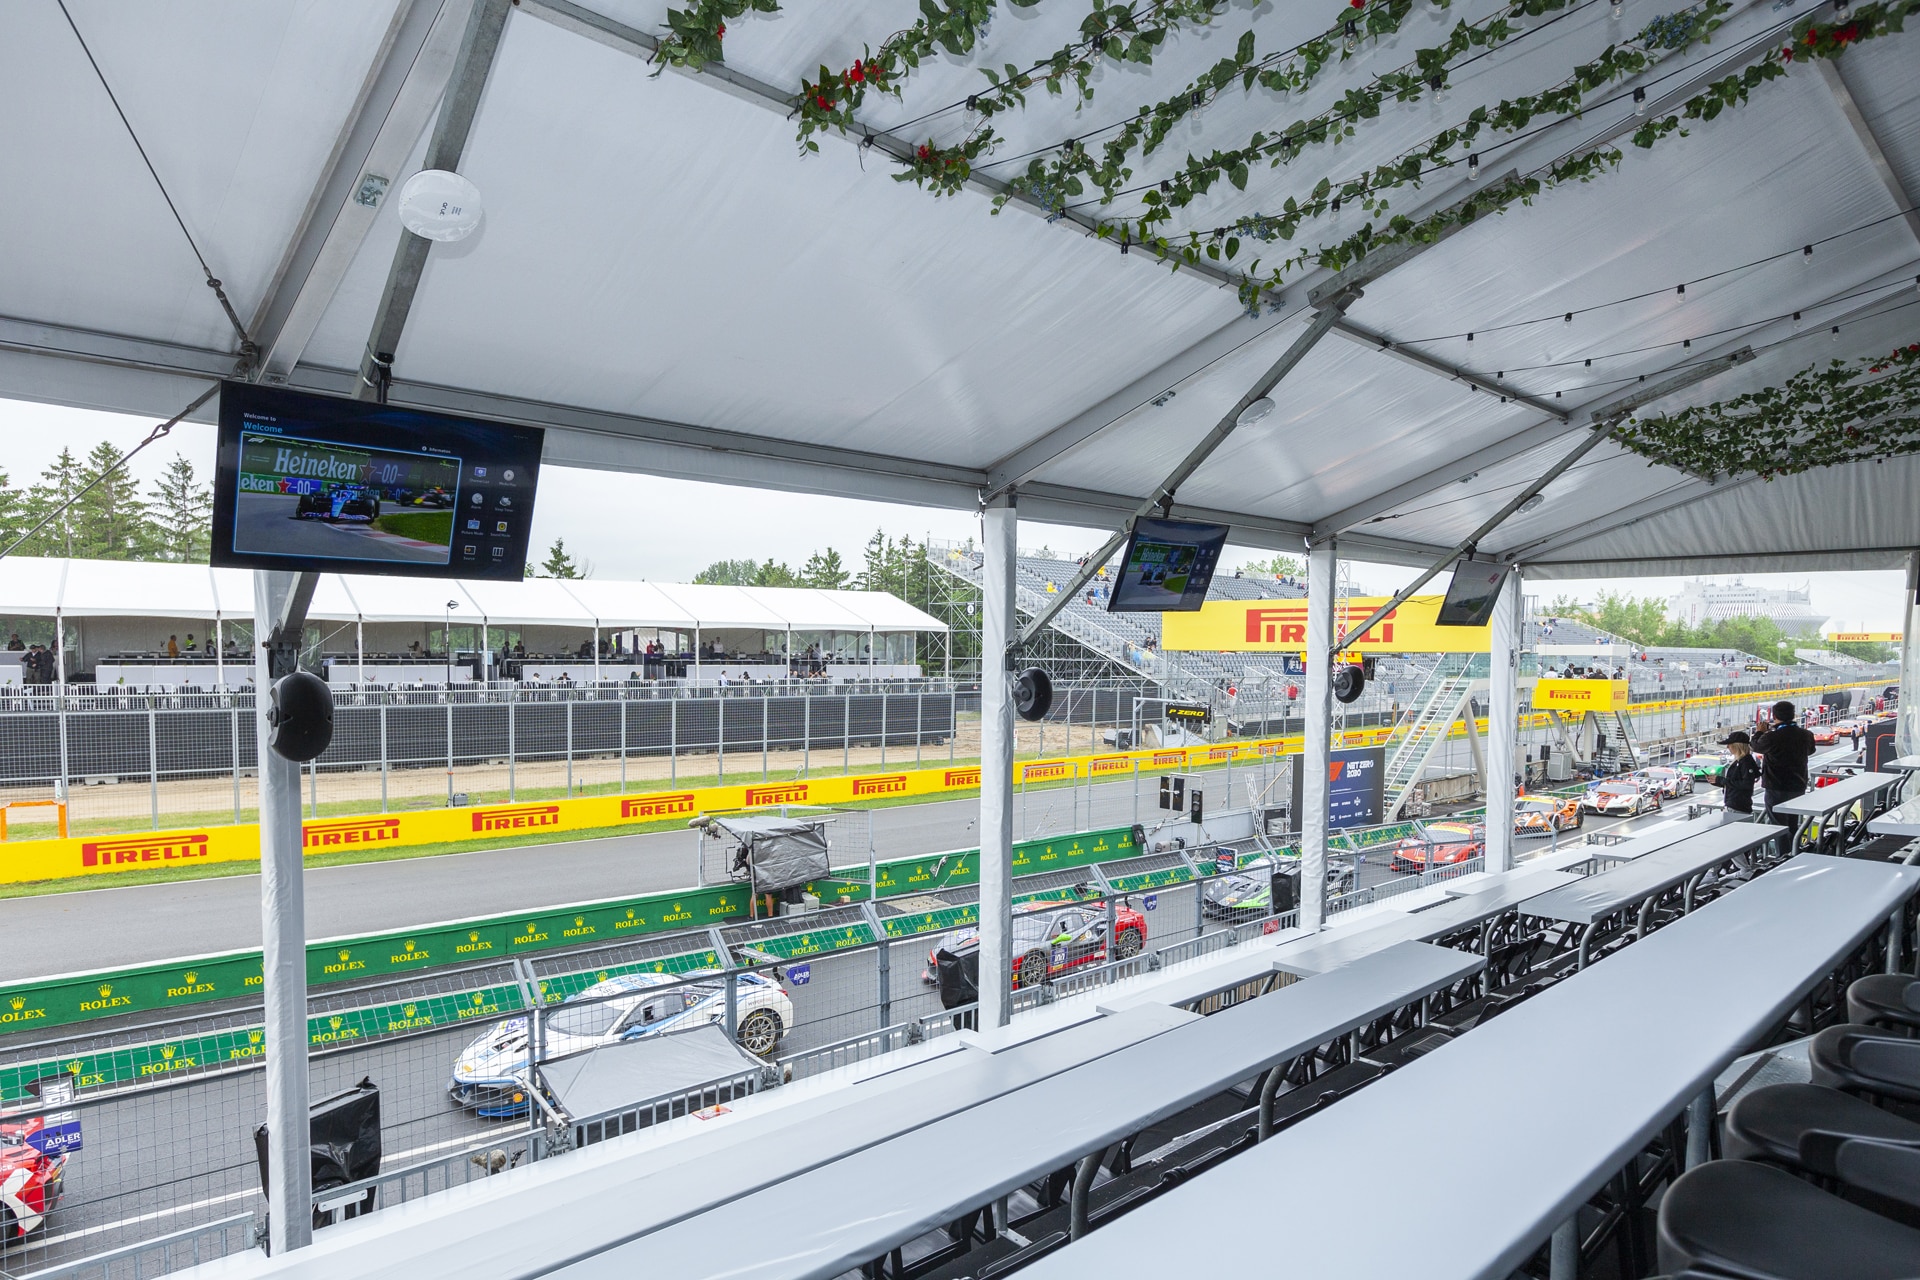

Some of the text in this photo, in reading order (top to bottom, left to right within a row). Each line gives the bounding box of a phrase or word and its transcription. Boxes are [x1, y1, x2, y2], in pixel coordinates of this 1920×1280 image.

[244, 412, 269, 421] Welcome
[244, 421, 283, 434] Welcome
[273, 447, 357, 481] Heineken
[1550, 690, 1592, 700] PIRELLI
[1177, 709, 1204, 717] ZERO
[1209, 746, 1238, 760] PIRELLI
[1258, 742, 1284, 754] PIRELLI
[1093, 756, 1128, 771] PIRELLI
[1154, 750, 1186, 765] PIRELLI
[1024, 762, 1065, 778] PIRELLI
[1346, 760, 1374, 770] NET ZERO
[945, 769, 981, 786] PIREL
[1346, 769, 1362, 778] 2030
[853, 776, 907, 795] PIRELLI
[746, 784, 808, 806] PIRELLI
[621, 794, 695, 818] PIRELLI
[472, 806, 560, 832] PIRELLI
[302, 818, 400, 847] PIRELLI
[82, 834, 209, 867] PIRELLI
[1040, 852, 1058, 860] ROLEX
[908, 874, 930, 882] ROLEX
[950, 868, 970, 876] ROLEX
[837, 885, 860, 894] ROLEX
[710, 904, 736, 915] ROLEX
[615, 918, 646, 929] ROLEX
[663, 912, 692, 922] ROLEX
[954, 916, 976, 925] ROLEX
[564, 926, 596, 937] ROLEX
[917, 922, 940, 932] ROLEX
[514, 932, 548, 944] ROLEX
[836, 937, 862, 948] ROLEX
[456, 941, 492, 953] ROLEX
[792, 944, 820, 956] ROLEX
[390, 950, 430, 964] ROLEX
[324, 960, 366, 974] ROLEX
[167, 982, 216, 997] ROLEX
[80, 996, 132, 1012] ROLEX
[458, 1004, 498, 1018] ROLEX
[388, 1016, 432, 1031] ROLEX
[312, 1028, 359, 1044] ROLEX
[140, 1058, 196, 1076] ROLEX
[46, 1132, 80, 1146] ADLER
